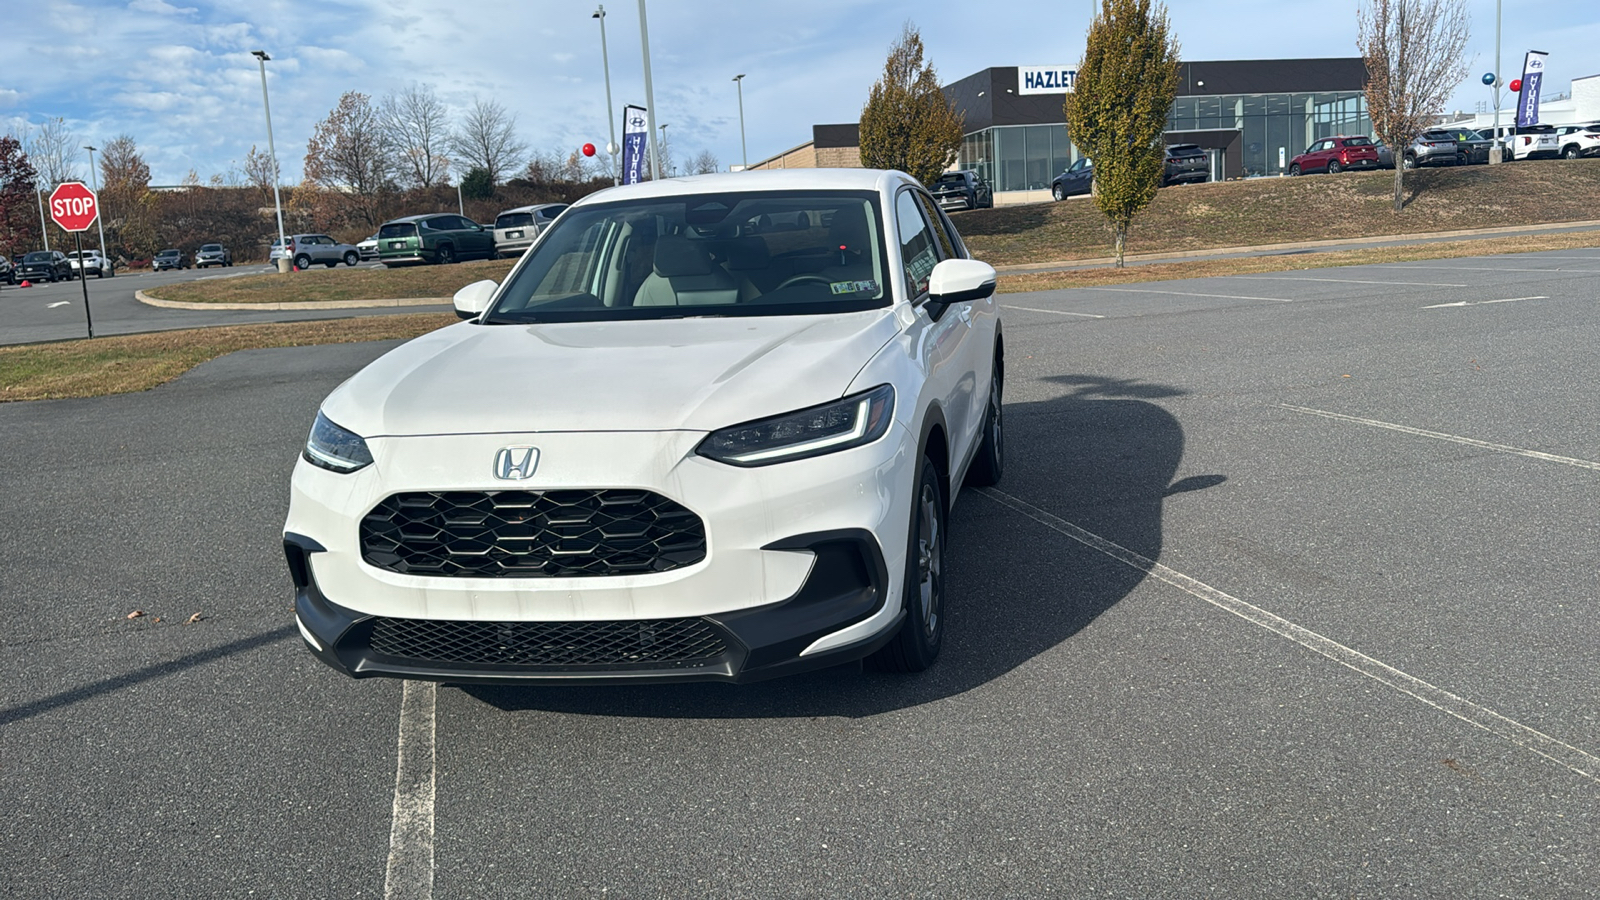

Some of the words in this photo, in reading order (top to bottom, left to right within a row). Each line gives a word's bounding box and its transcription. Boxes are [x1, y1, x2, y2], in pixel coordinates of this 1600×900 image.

[1025, 71, 1080, 88] HAZLET
[1525, 75, 1538, 125] HYUNDAI
[53, 197, 93, 217] STOP
